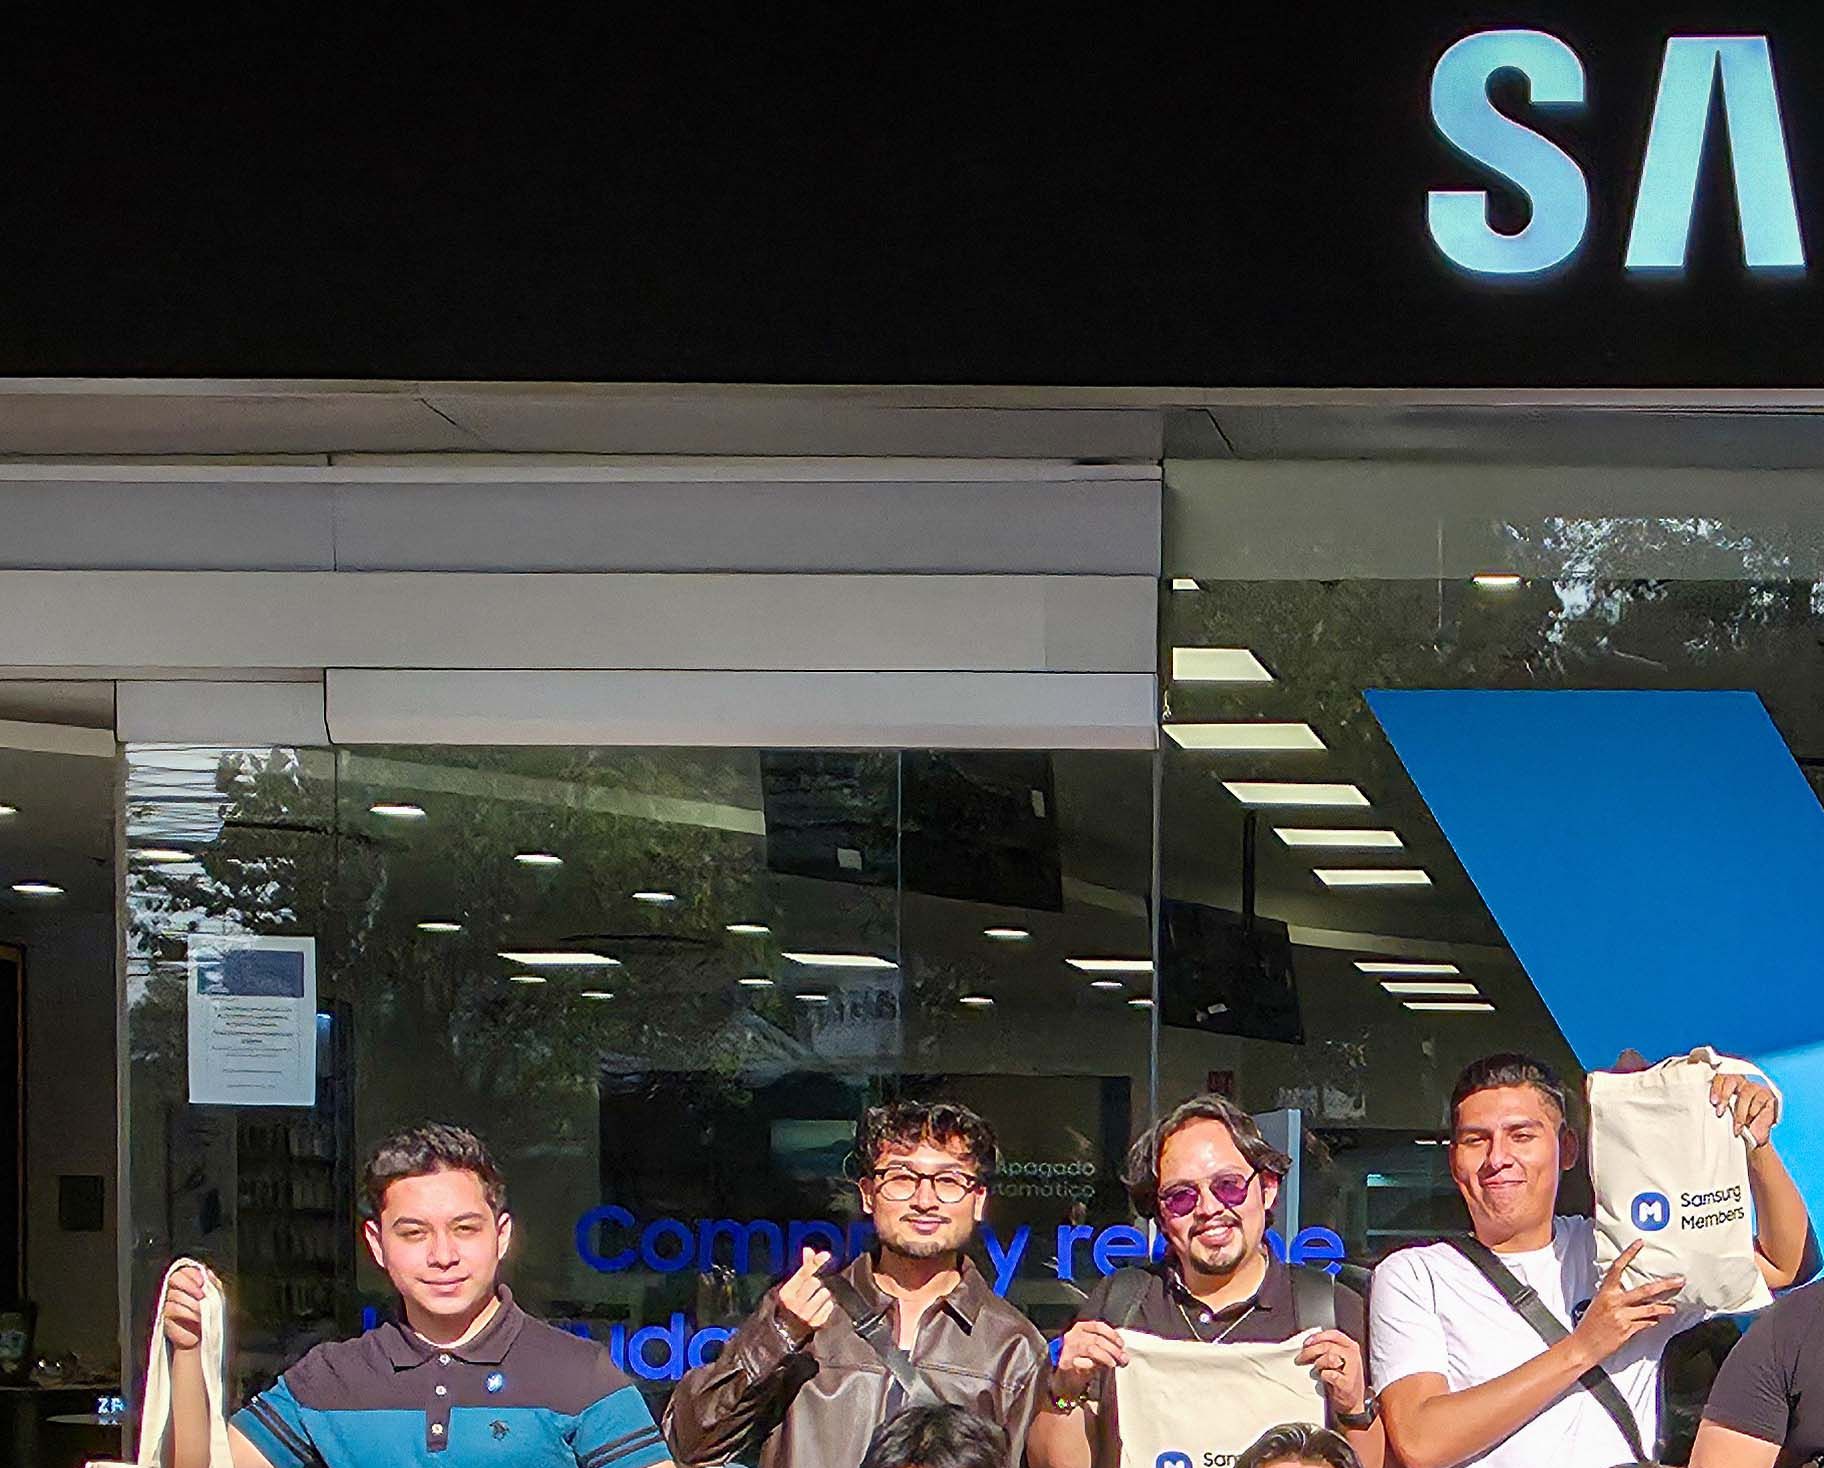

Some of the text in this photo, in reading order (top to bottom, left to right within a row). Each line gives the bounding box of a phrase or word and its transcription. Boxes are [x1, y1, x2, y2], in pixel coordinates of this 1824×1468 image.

[1680, 1184, 1742, 1208] Samsung
[1681, 1206, 1745, 1231] Members
[574, 1203, 877, 1275] Compr
[977, 1223, 1031, 1297] y
